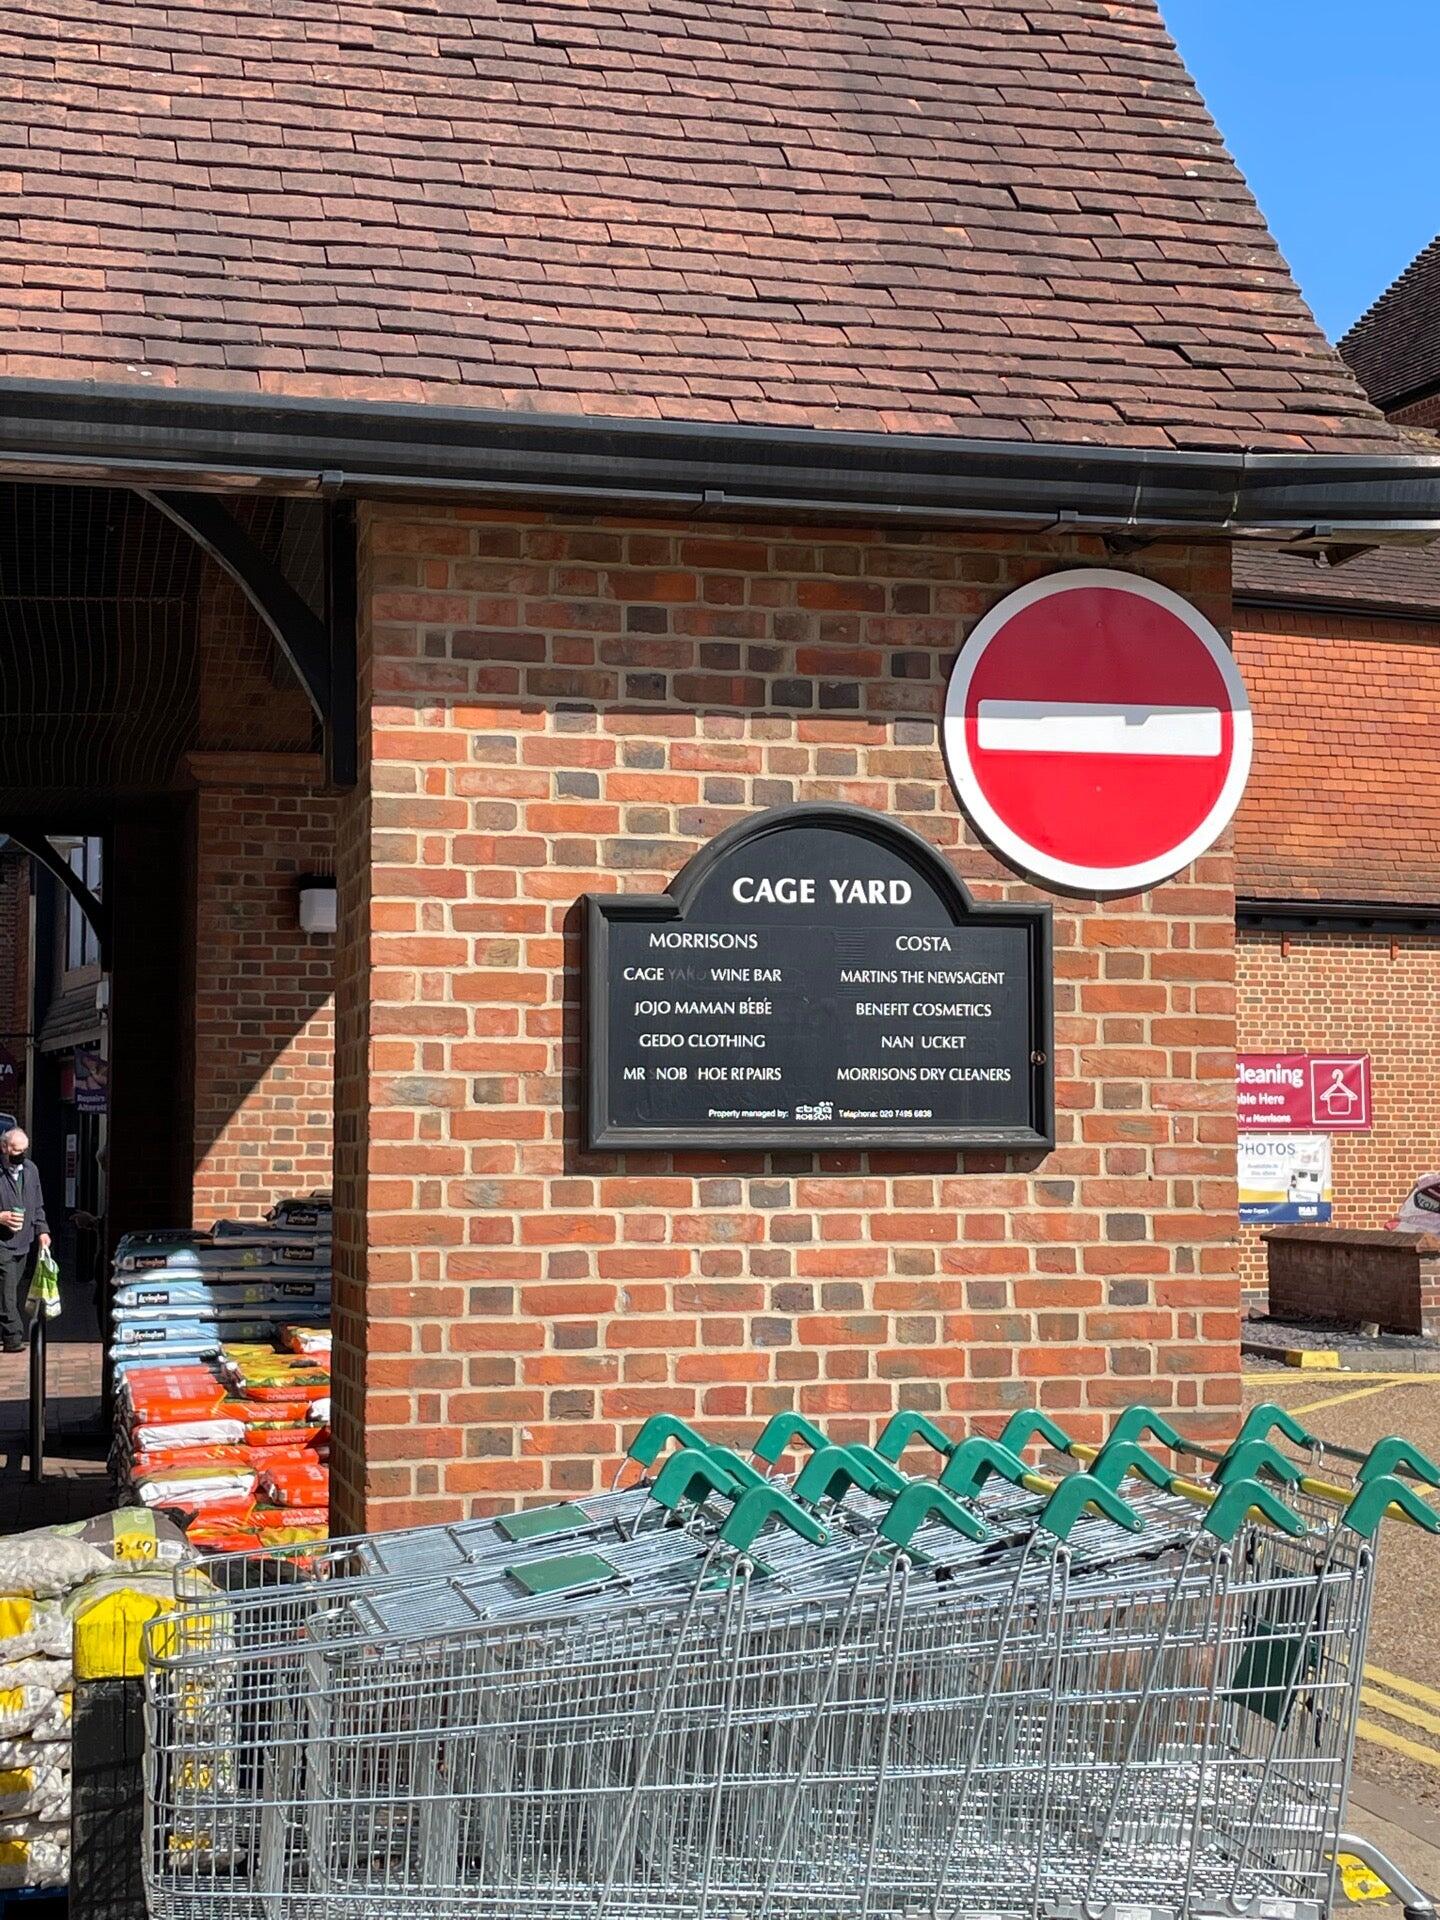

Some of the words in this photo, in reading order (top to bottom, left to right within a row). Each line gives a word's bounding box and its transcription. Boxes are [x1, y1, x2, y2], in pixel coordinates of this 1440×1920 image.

[733, 878, 815, 904] CAGE
[829, 879, 911, 904] YARD
[650, 933, 758, 949] MORRISONS
[895, 936, 951, 951] COSTA
[624, 968, 664, 981] CAGE
[711, 968, 750, 981] WINE
[754, 968, 782, 981] BAR
[841, 970, 898, 983] MARTINS
[901, 970, 924, 983] THE
[928, 971, 1005, 984] NEWSAGENT
[634, 1001, 671, 1016] JOJO
[675, 1002, 735, 1014] MAMAN
[856, 1003, 910, 1016] BENEFIT
[913, 1003, 992, 1016] COSMETICS
[639, 1034, 684, 1047] GEDO
[688, 1034, 766, 1047] CLOTHING
[623, 1067, 646, 1080] MR
[837, 1067, 917, 1080] MORRISONS
[920, 1068, 947, 1080] DRY
[949, 1068, 1011, 1081] CLEANERS
[1258, 1092, 1285, 1105] Here
[708, 1109, 741, 1118] Property
[741, 1109, 776, 1118] managed
[880, 1109, 893, 1117] 020
